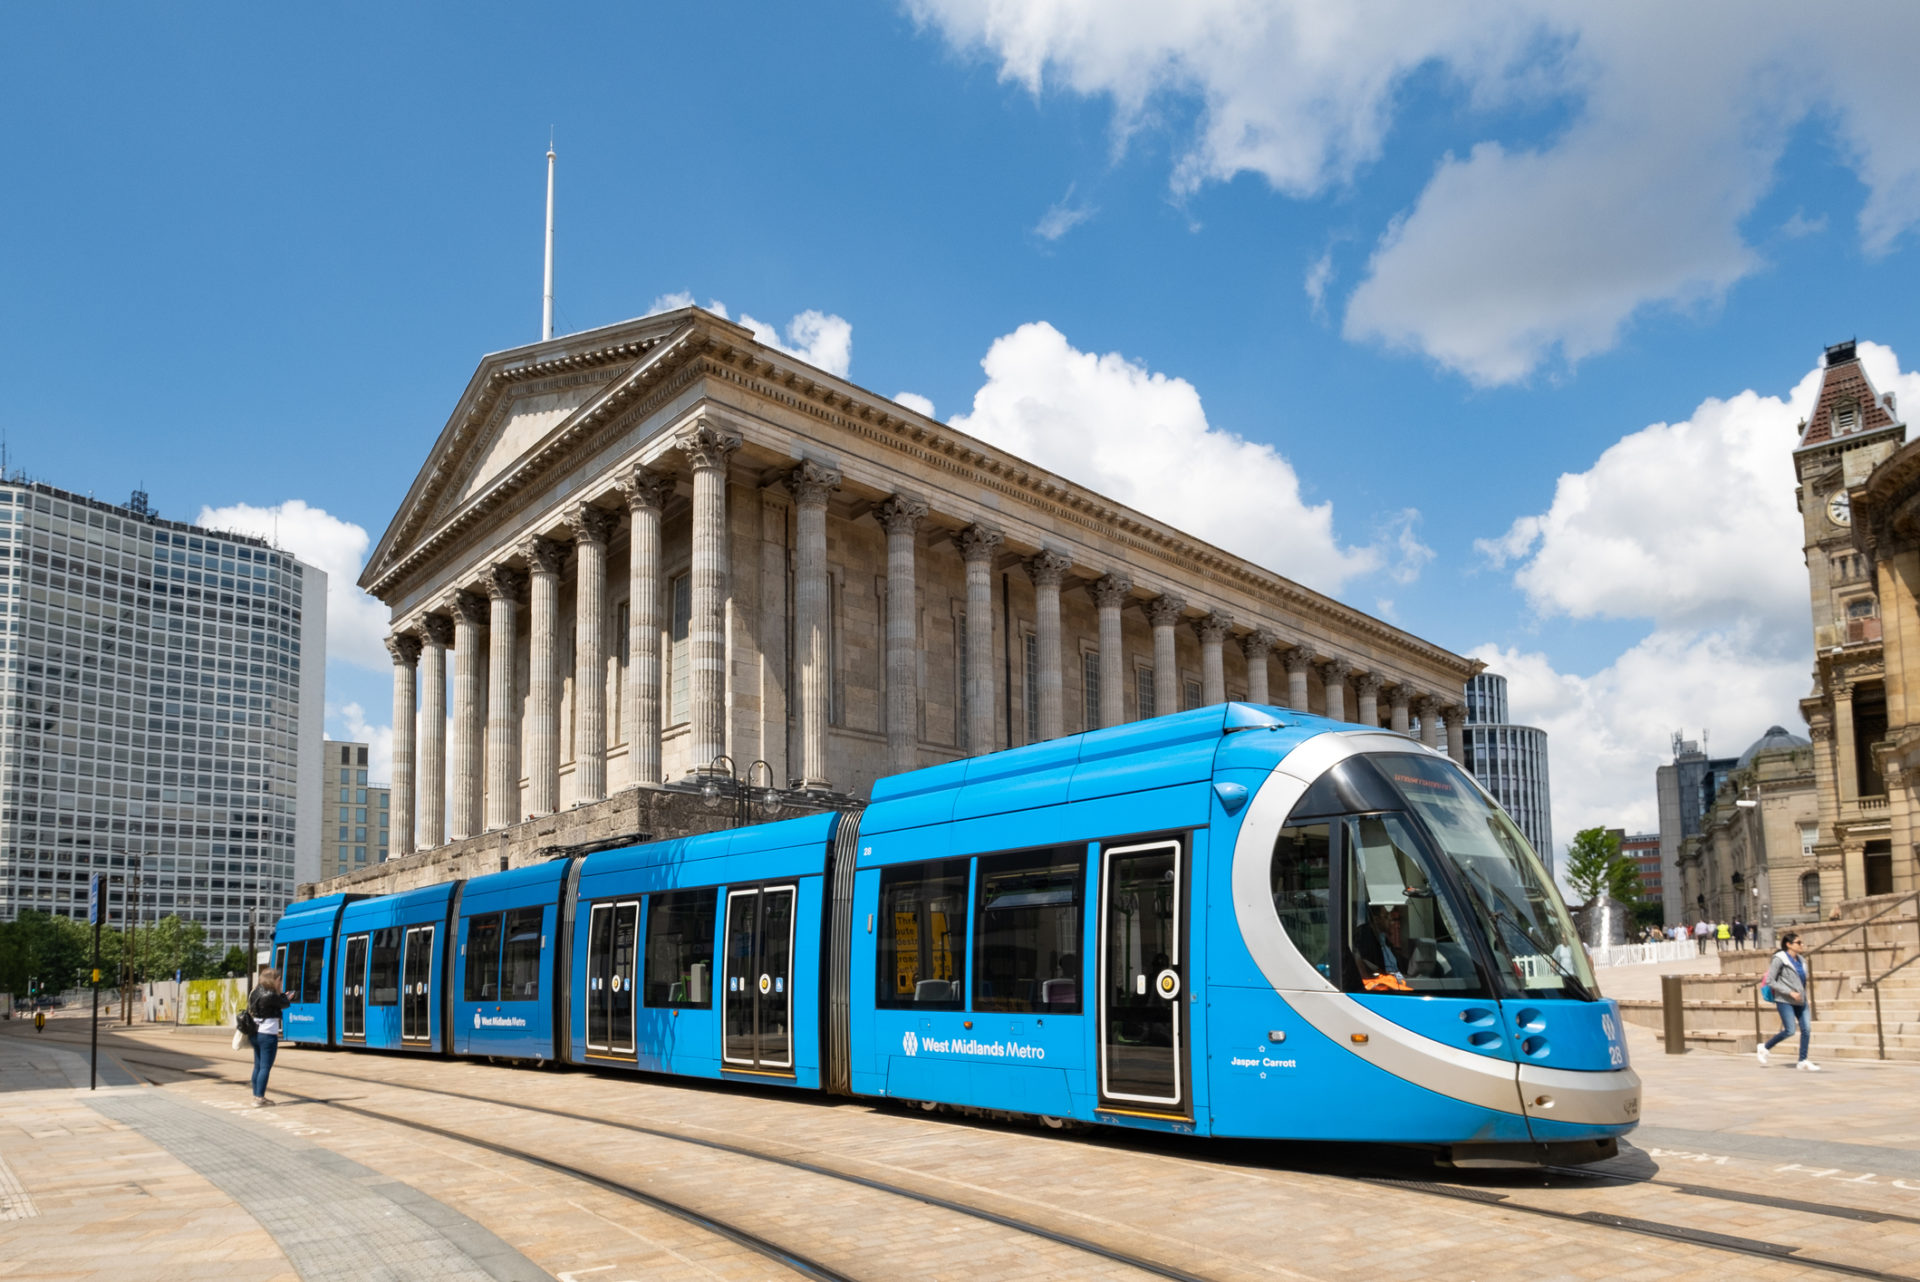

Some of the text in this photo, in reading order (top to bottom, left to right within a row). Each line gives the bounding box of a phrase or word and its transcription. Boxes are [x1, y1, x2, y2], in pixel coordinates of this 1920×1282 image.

[863, 847, 872, 856] 28
[921, 1037, 1045, 1060] West Midlands Metro
[1608, 1046, 1624, 1065] 28
[1231, 1056, 1296, 1067] Jasper Carrott
